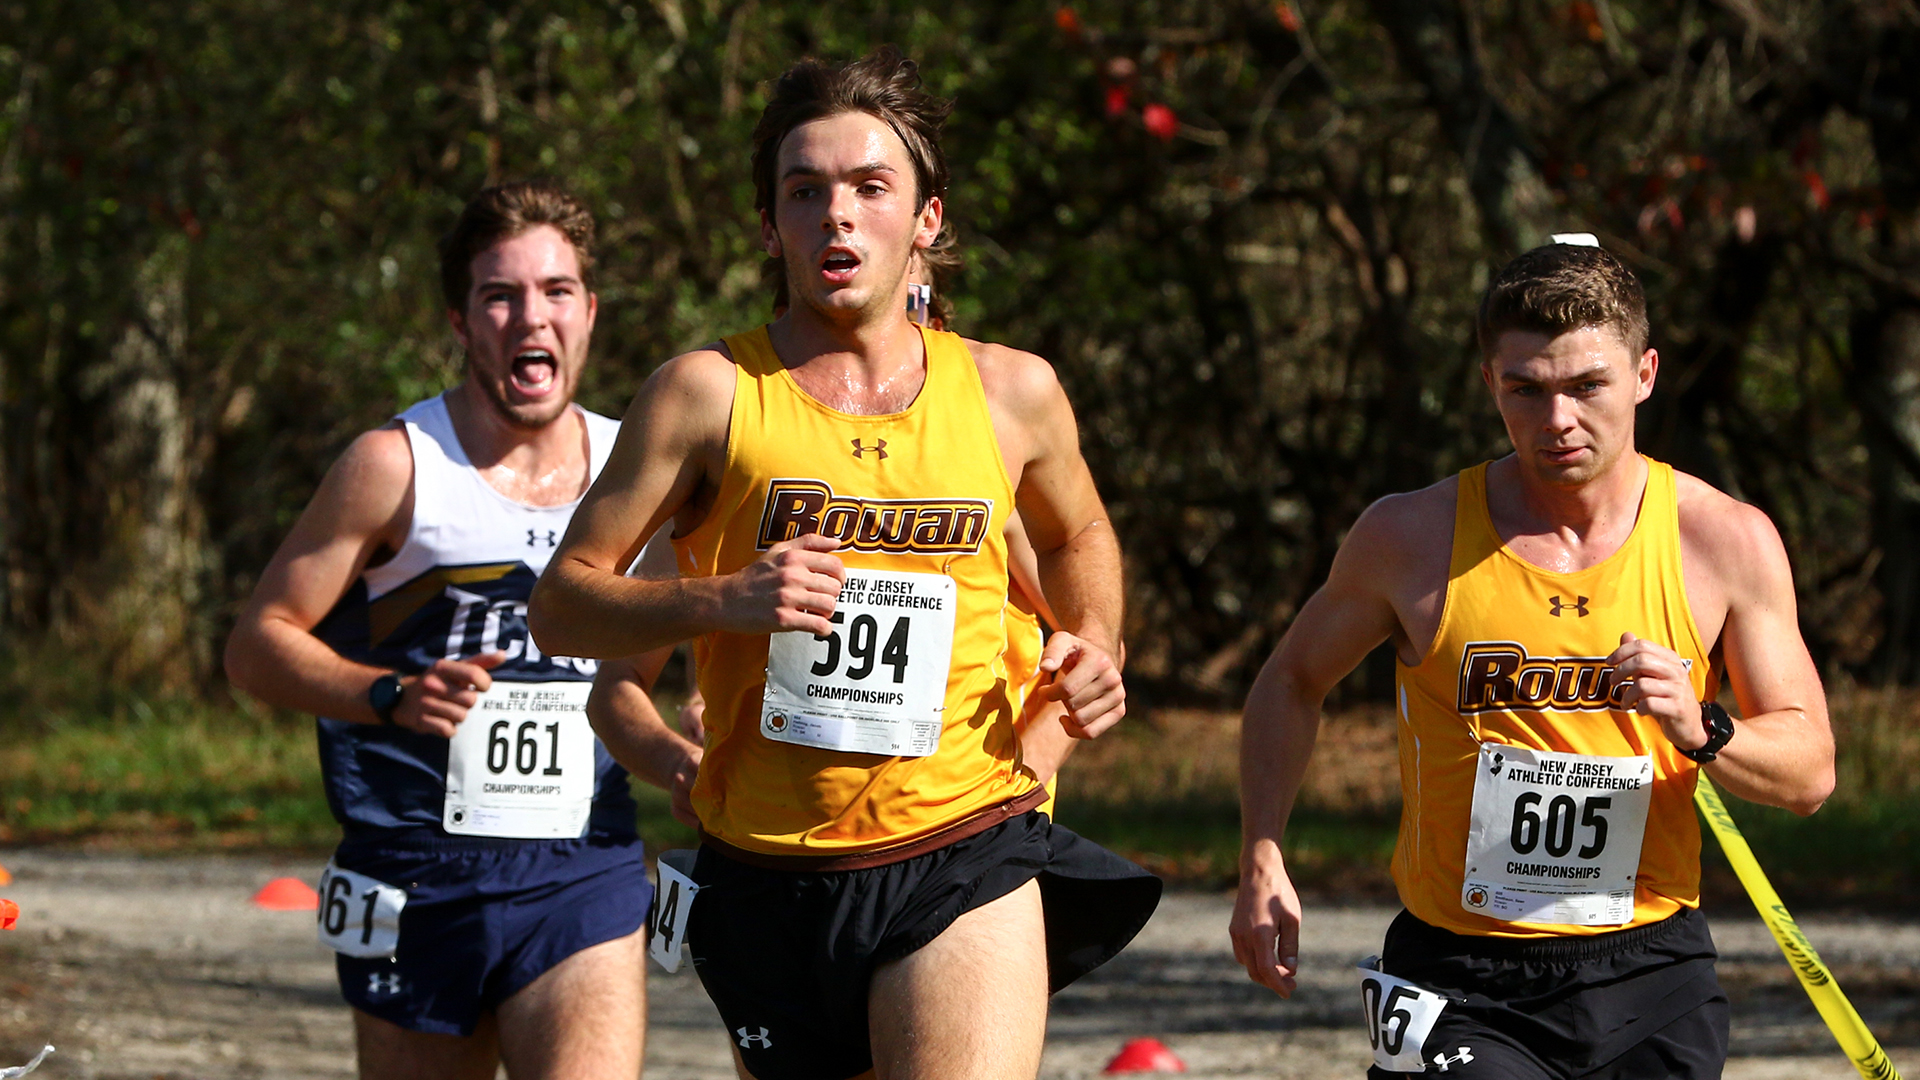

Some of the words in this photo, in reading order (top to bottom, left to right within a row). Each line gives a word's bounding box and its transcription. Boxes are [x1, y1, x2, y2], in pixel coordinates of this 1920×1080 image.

[755, 478, 994, 555] Rowan
[841, 578, 867, 591] NEW
[871, 580, 915, 594] JERSEY
[868, 593, 943, 611] CONFERENCE
[810, 611, 910, 684] 594
[806, 683, 904, 706] CHAMPIONSHIPS
[487, 720, 563, 776] 661
[1507, 768, 1563, 787] ATHLETIC
[1566, 776, 1641, 791] CONFERENCE
[1539, 759, 1567, 774] NEW
[1569, 762, 1614, 777] JERSEY
[1510, 791, 1612, 860] 605
[1506, 861, 1601, 880] CHAMPIONSHIPS
